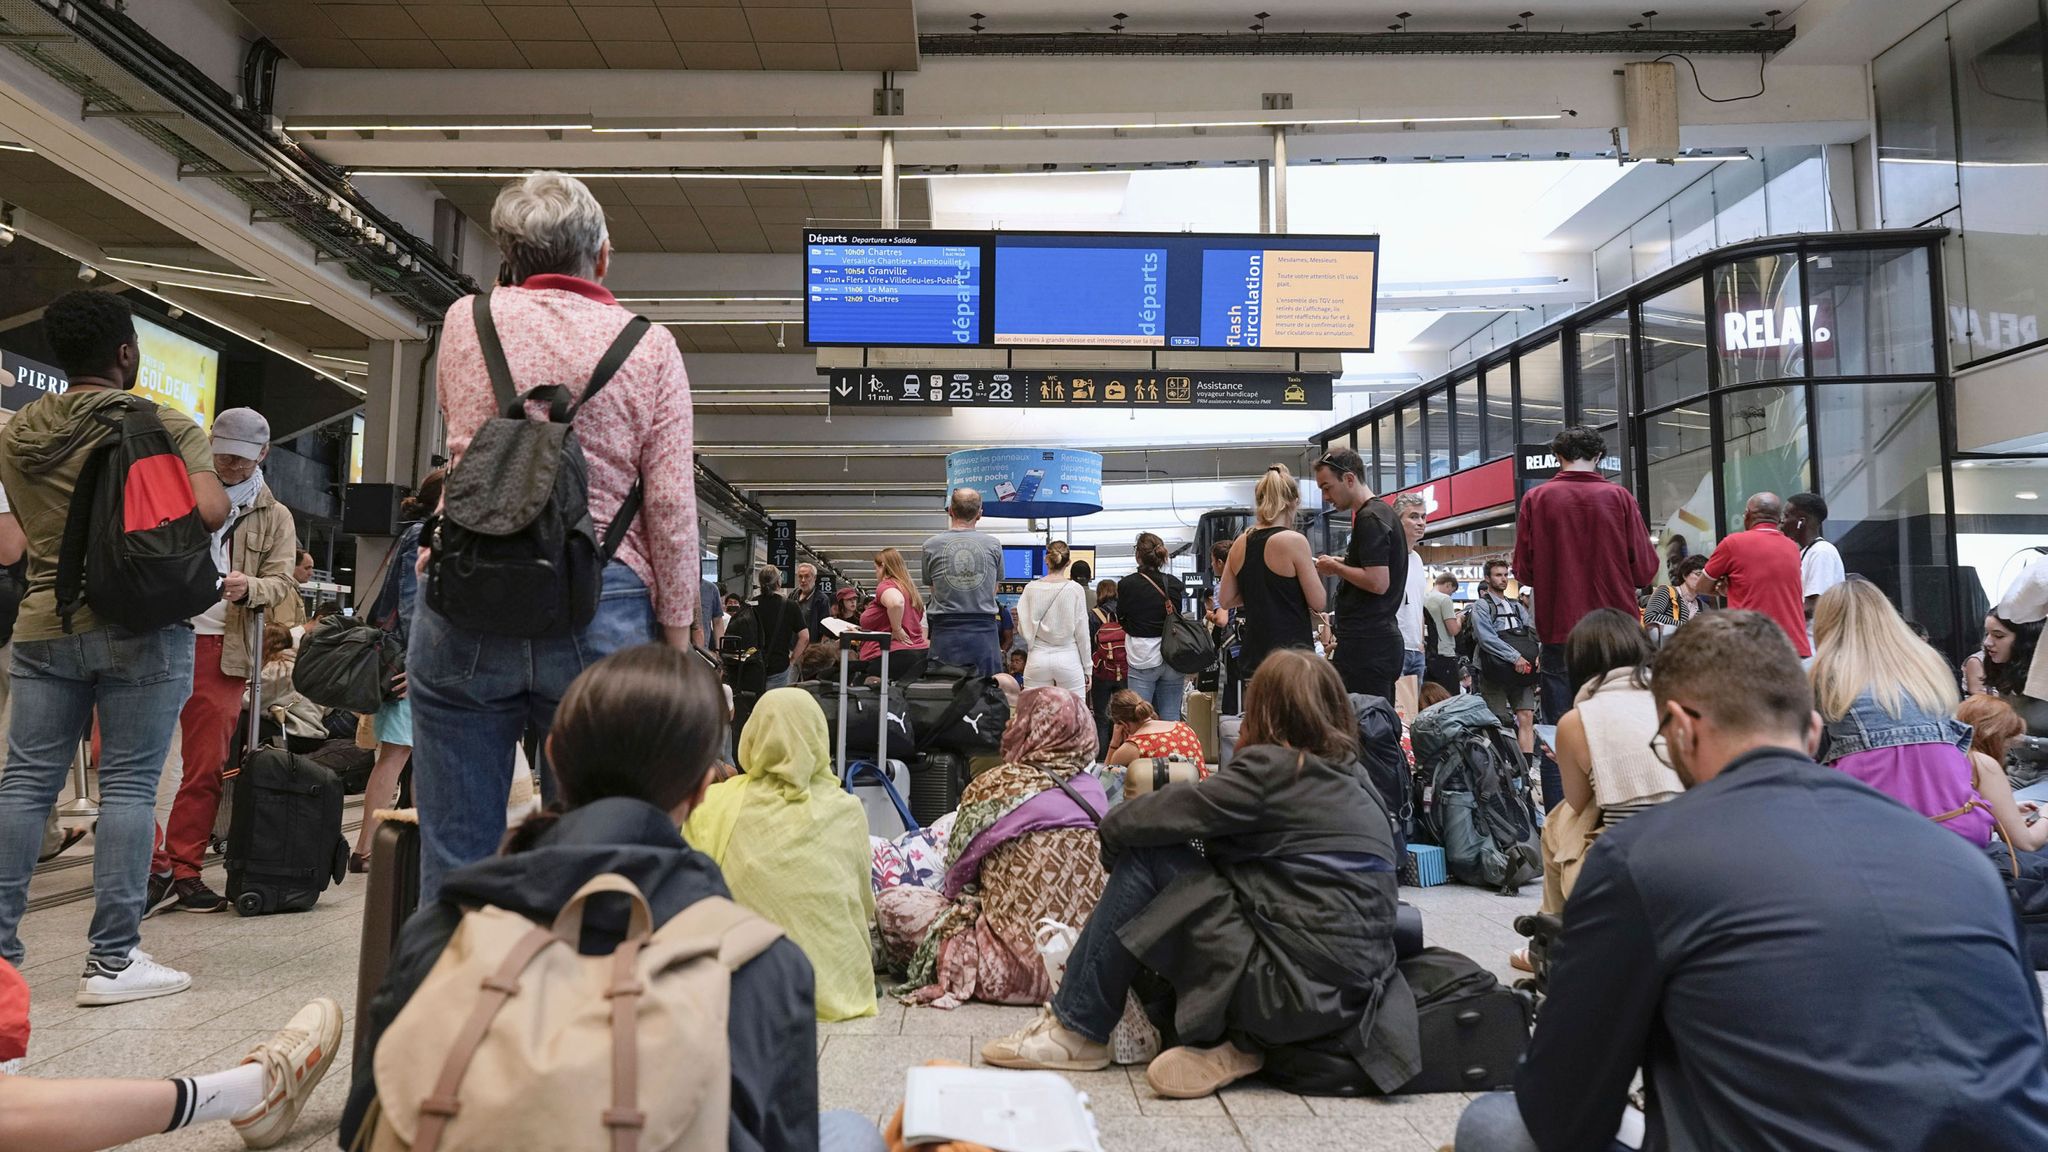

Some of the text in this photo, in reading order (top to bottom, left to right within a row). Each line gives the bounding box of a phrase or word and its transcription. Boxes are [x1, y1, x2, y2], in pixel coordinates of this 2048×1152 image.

[808, 233, 847, 245] Départs
[852, 236, 887, 245] Departures
[844, 248, 865, 256] 10h09
[868, 248, 902, 256] Chartres
[842, 257, 962, 265] Versailles Chantiers Rambouillet
[844, 267, 865, 275] 10h54
[868, 266, 907, 275] Granville
[1310, 273, 1336, 281] attention
[868, 295, 899, 303] Chartres
[1138, 252, 1161, 336] départs
[952, 260, 975, 343] départs
[1243, 255, 1261, 347] circulation
[1226, 306, 1242, 346] flash
[1724, 304, 1819, 351] RELAY
[1096, 337, 1132, 346] interrompue
[1149, 338, 1163, 346] ligne
[949, 380, 1013, 399] 25 à 28
[1197, 381, 1243, 390] Assistance
[1197, 390, 1258, 399] voyageur handicapé
[980, 456, 990, 464] les
[991, 453, 1031, 463] panneaux
[1526, 453, 1557, 470] RELAY
[981, 463, 1009, 472] arrivées
[984, 471, 1009, 481] poche
[1060, 472, 1078, 481] dans
[775, 527, 790, 538] 10
[774, 554, 789, 566] 17
[819, 581, 832, 592] 18
